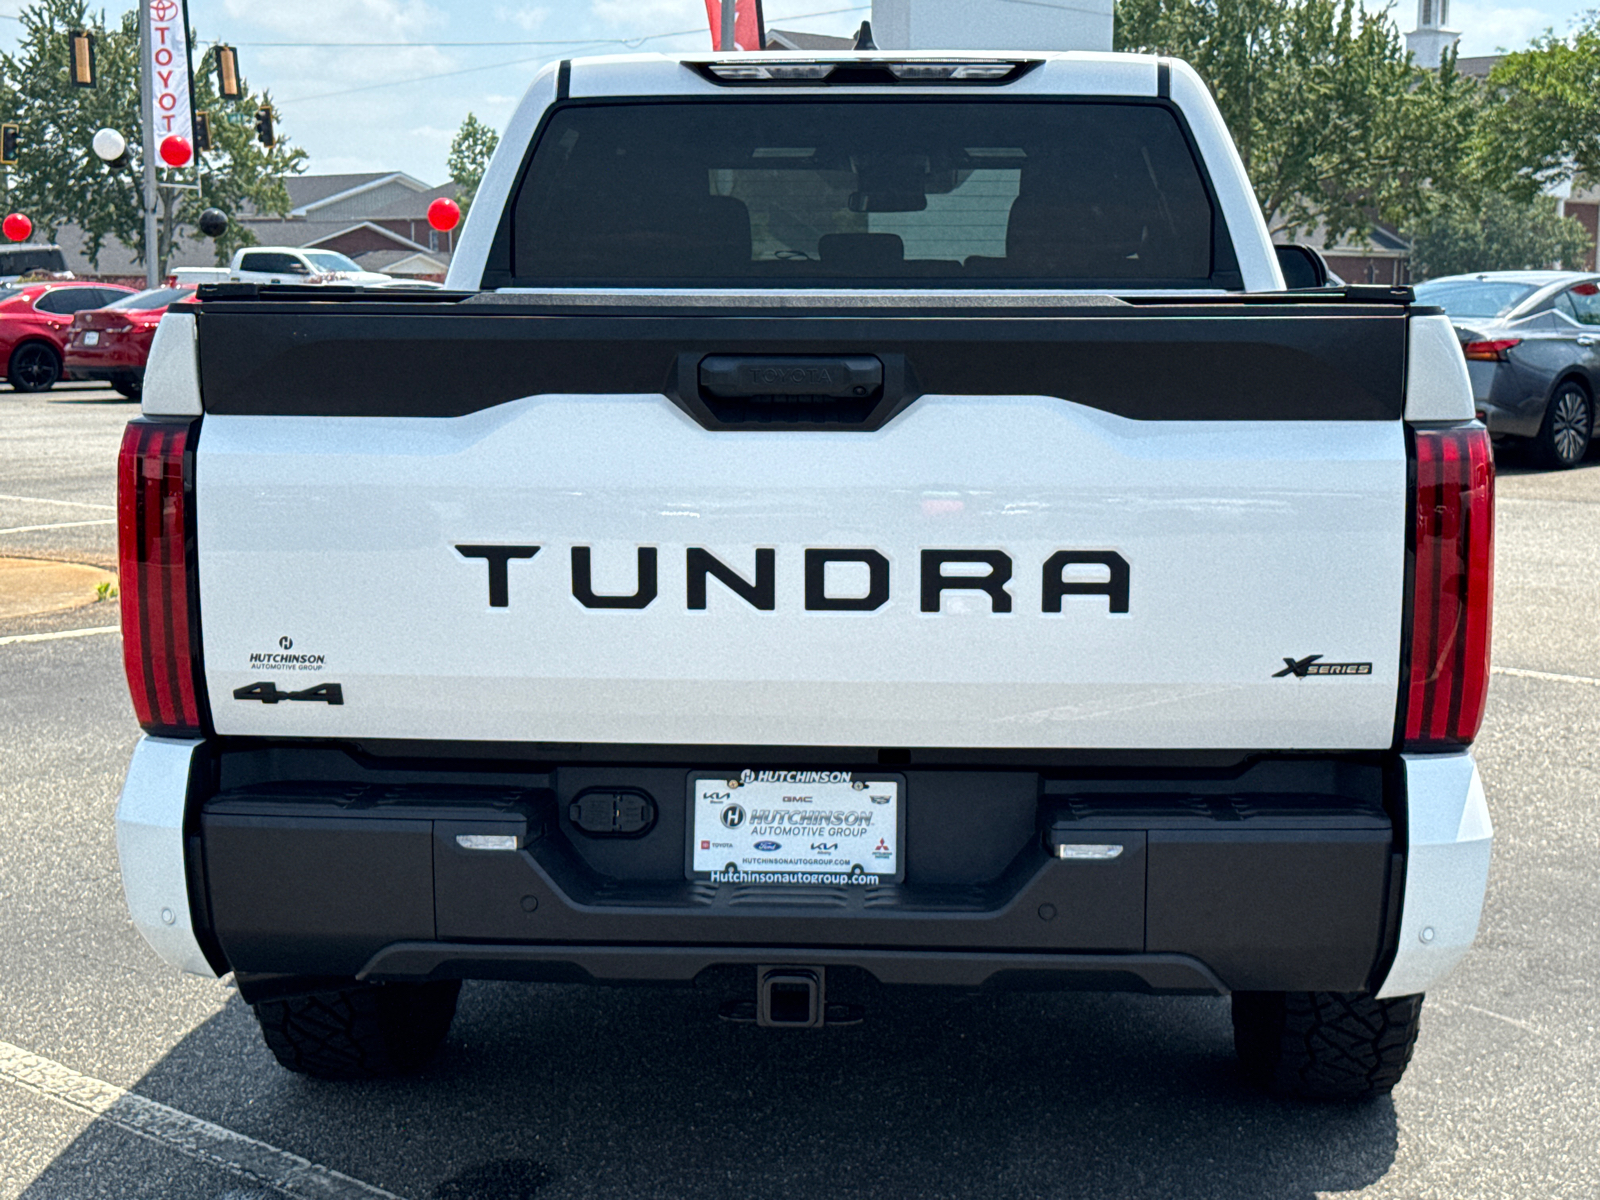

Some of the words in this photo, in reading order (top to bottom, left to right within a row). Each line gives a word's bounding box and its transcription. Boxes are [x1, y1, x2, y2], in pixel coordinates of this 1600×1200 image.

[154, 26, 177, 133] TOYOT
[750, 368, 832, 384] TOYOTA
[454, 543, 1131, 614] TUNDRA
[249, 653, 326, 665] HUTCHINSON
[250, 663, 297, 671] AUTOMOTIVE
[758, 770, 852, 784] HUTCHINSON
[782, 795, 813, 803] GMC
[748, 809, 874, 827] HUTCHINSON
[750, 826, 825, 837] AUTOMOTIVE
[828, 827, 868, 837] GROUP
[757, 842, 778, 850] Ford
[742, 857, 851, 866] HUTCHINSONAUTOGROUP.COM
[710, 871, 880, 885] Hutchinsonautogroup.com
